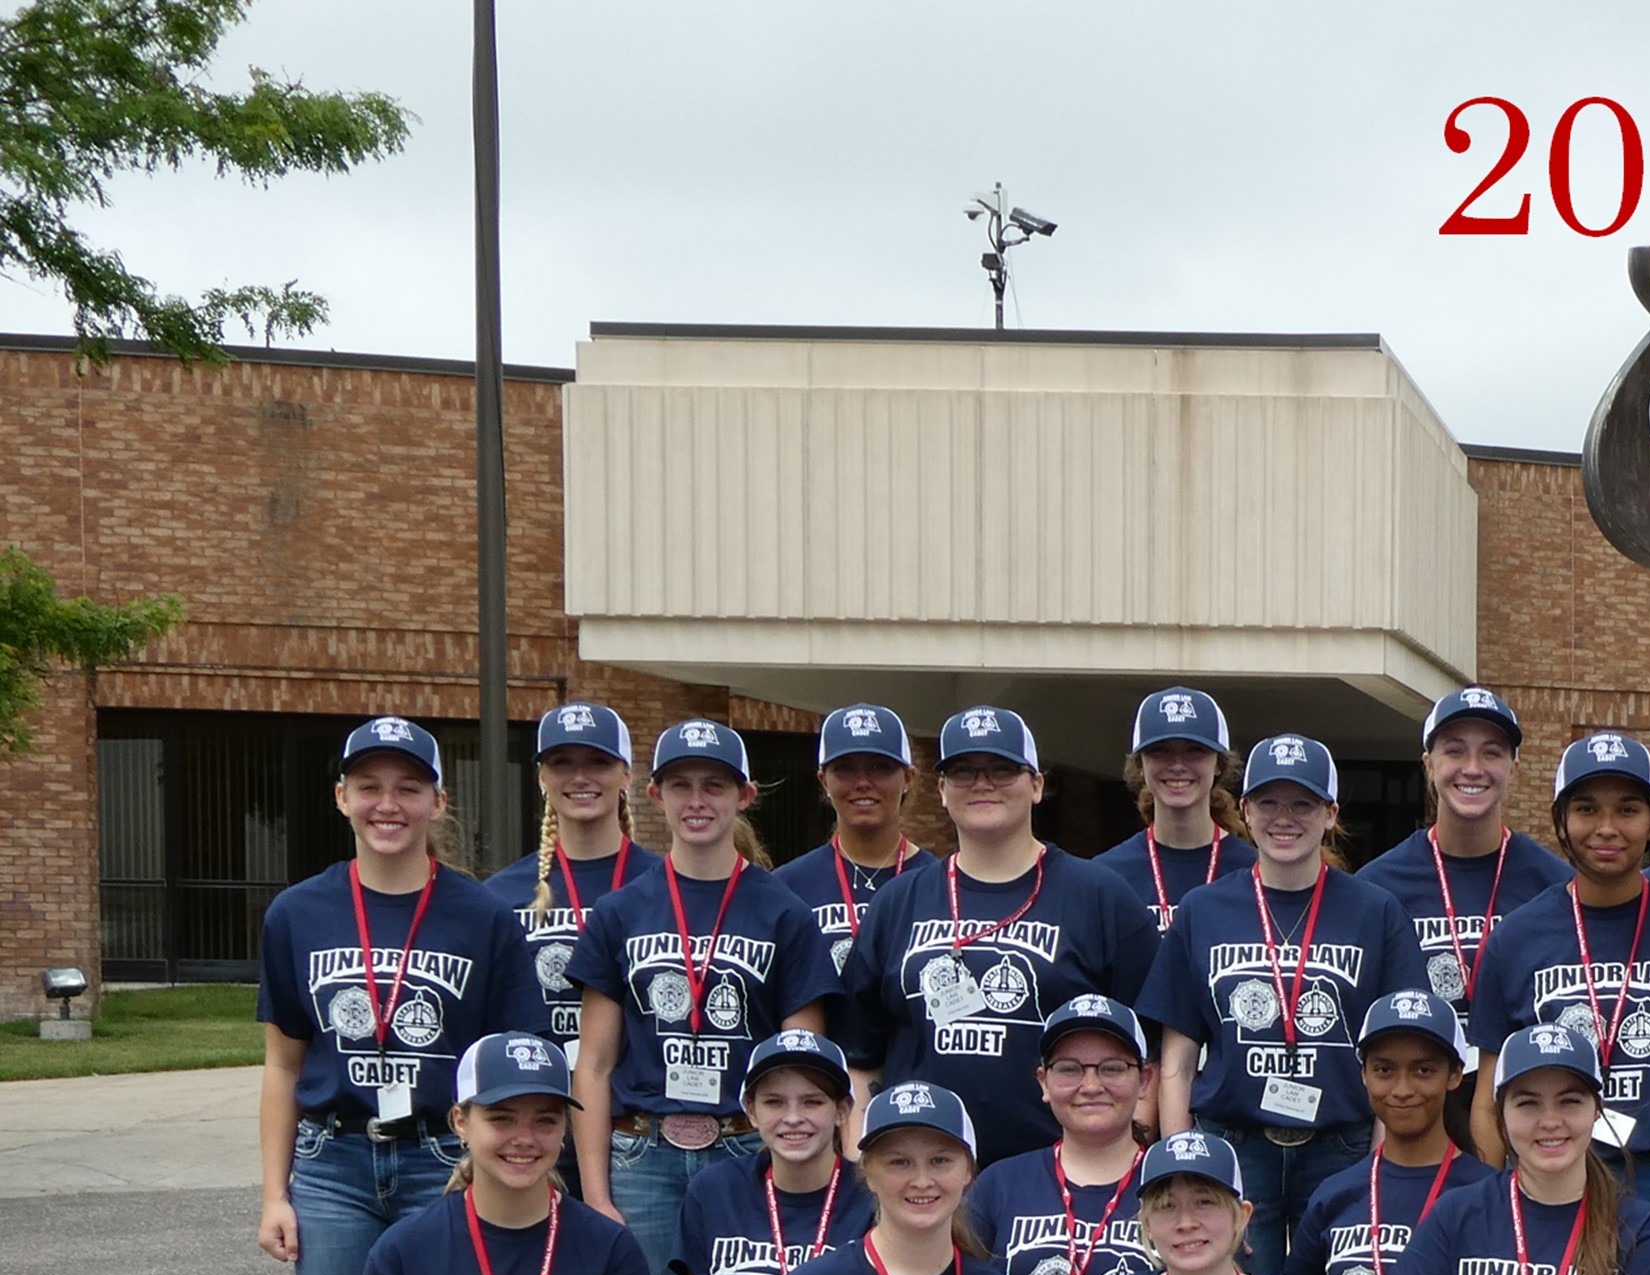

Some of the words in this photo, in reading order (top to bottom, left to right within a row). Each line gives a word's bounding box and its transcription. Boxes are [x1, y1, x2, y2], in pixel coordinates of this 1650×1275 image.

[715, 932, 776, 983] LAW
[1000, 921, 1060, 964] LAW
[408, 950, 474, 1000] LAW
[1298, 945, 1364, 988] LAW
[663, 1037, 730, 1071] CADET
[934, 1025, 1006, 1056] CADET
[349, 1056, 421, 1089] CADET
[1246, 1046, 1316, 1077] CADET
